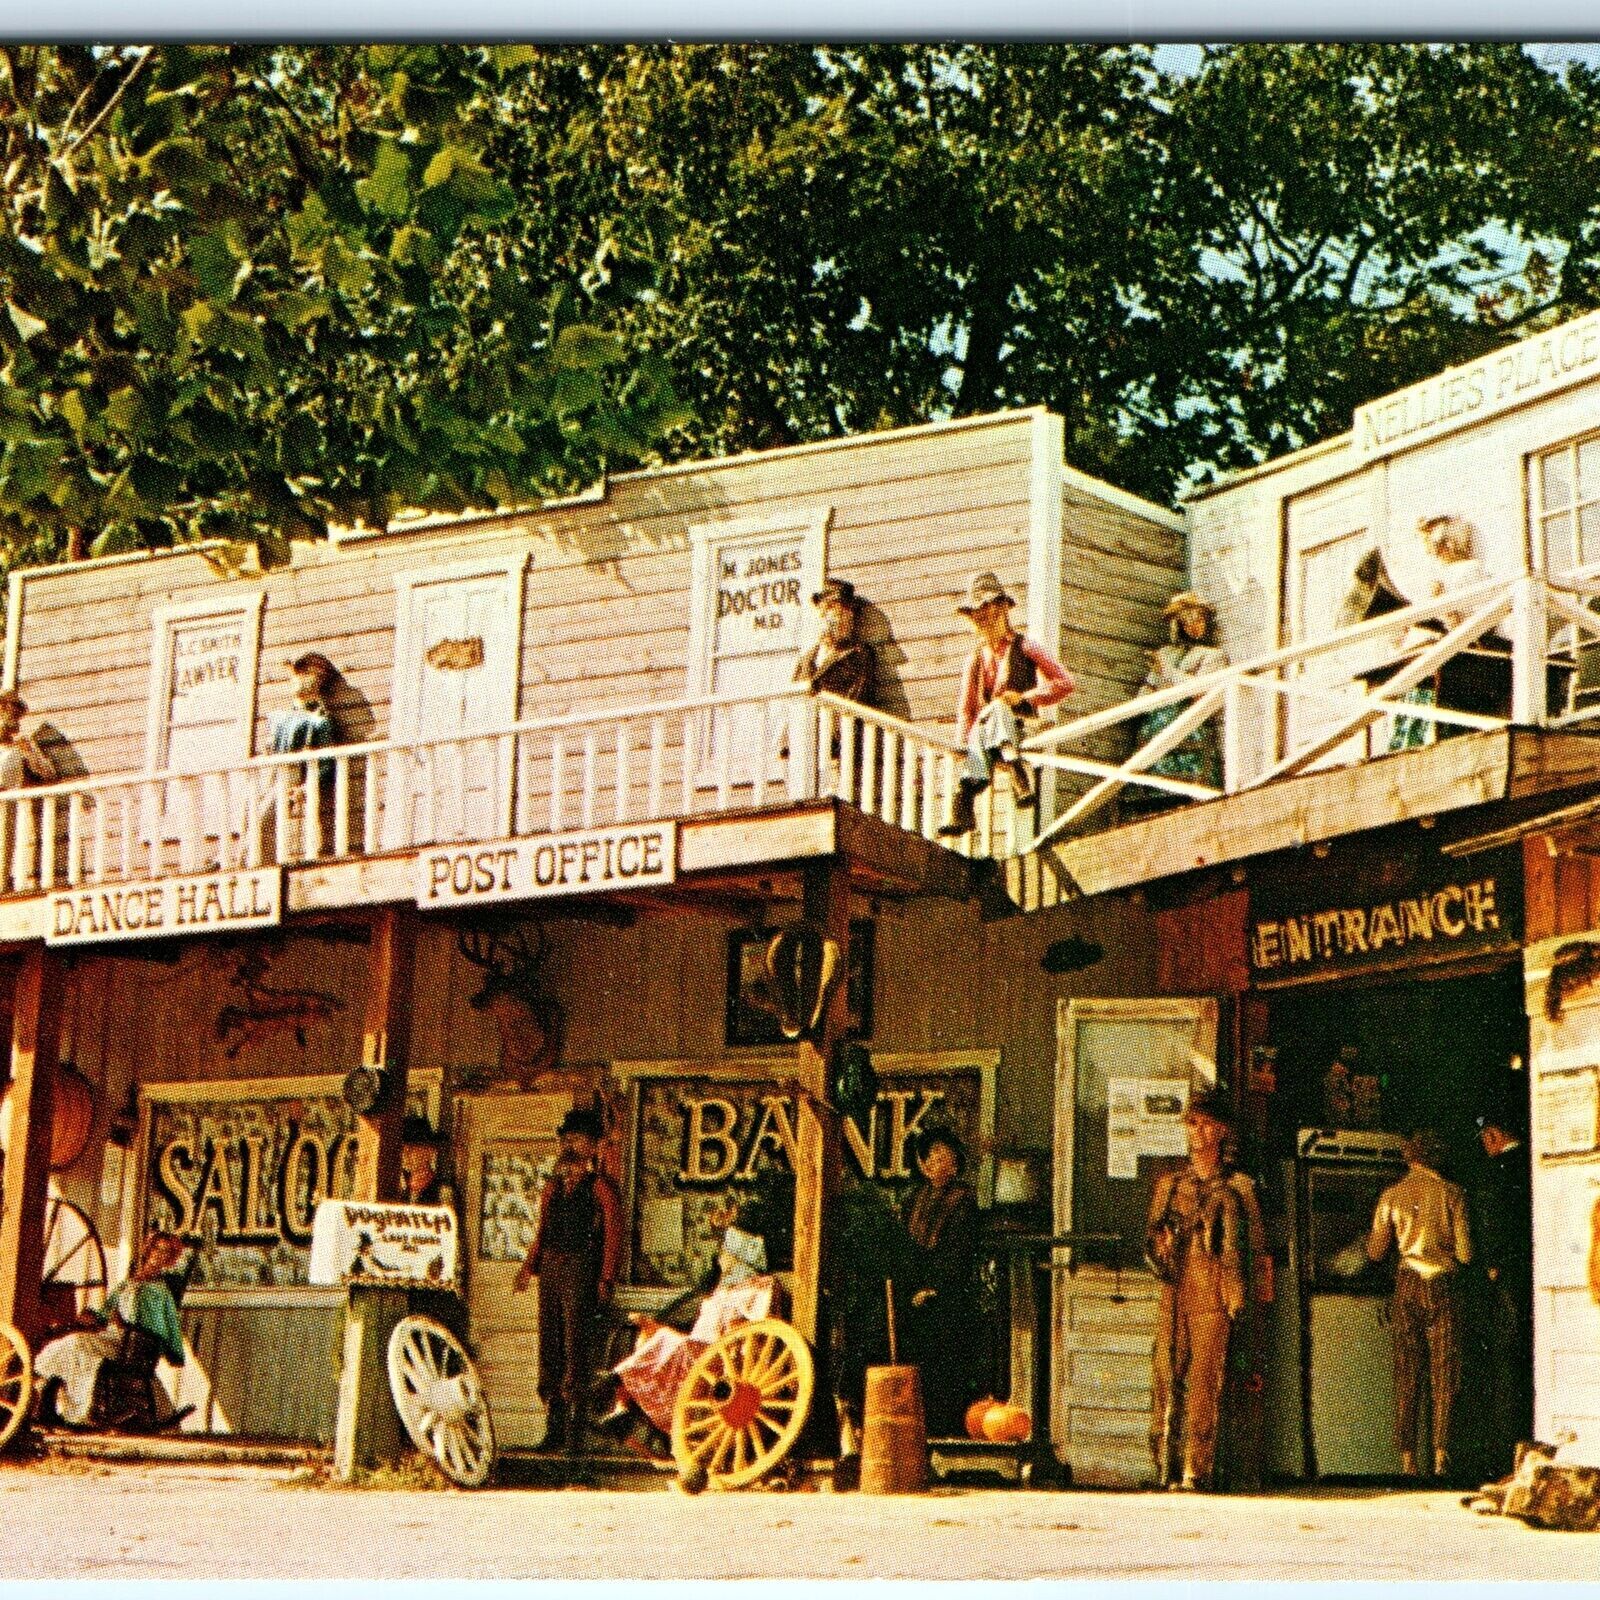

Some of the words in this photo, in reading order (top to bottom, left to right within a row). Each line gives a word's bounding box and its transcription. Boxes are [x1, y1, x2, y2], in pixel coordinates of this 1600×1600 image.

[1362, 367, 1486, 452] NELLIES
[1496, 321, 1600, 400] PLACE
[744, 551, 802, 578] JONES
[717, 578, 801, 618] DOCTOR
[428, 848, 518, 899] POST
[533, 832, 663, 886] OFFICE
[53, 887, 164, 938] DANCE
[175, 875, 273, 926] HALL
[1251, 878, 1500, 969] ENTRANCE
